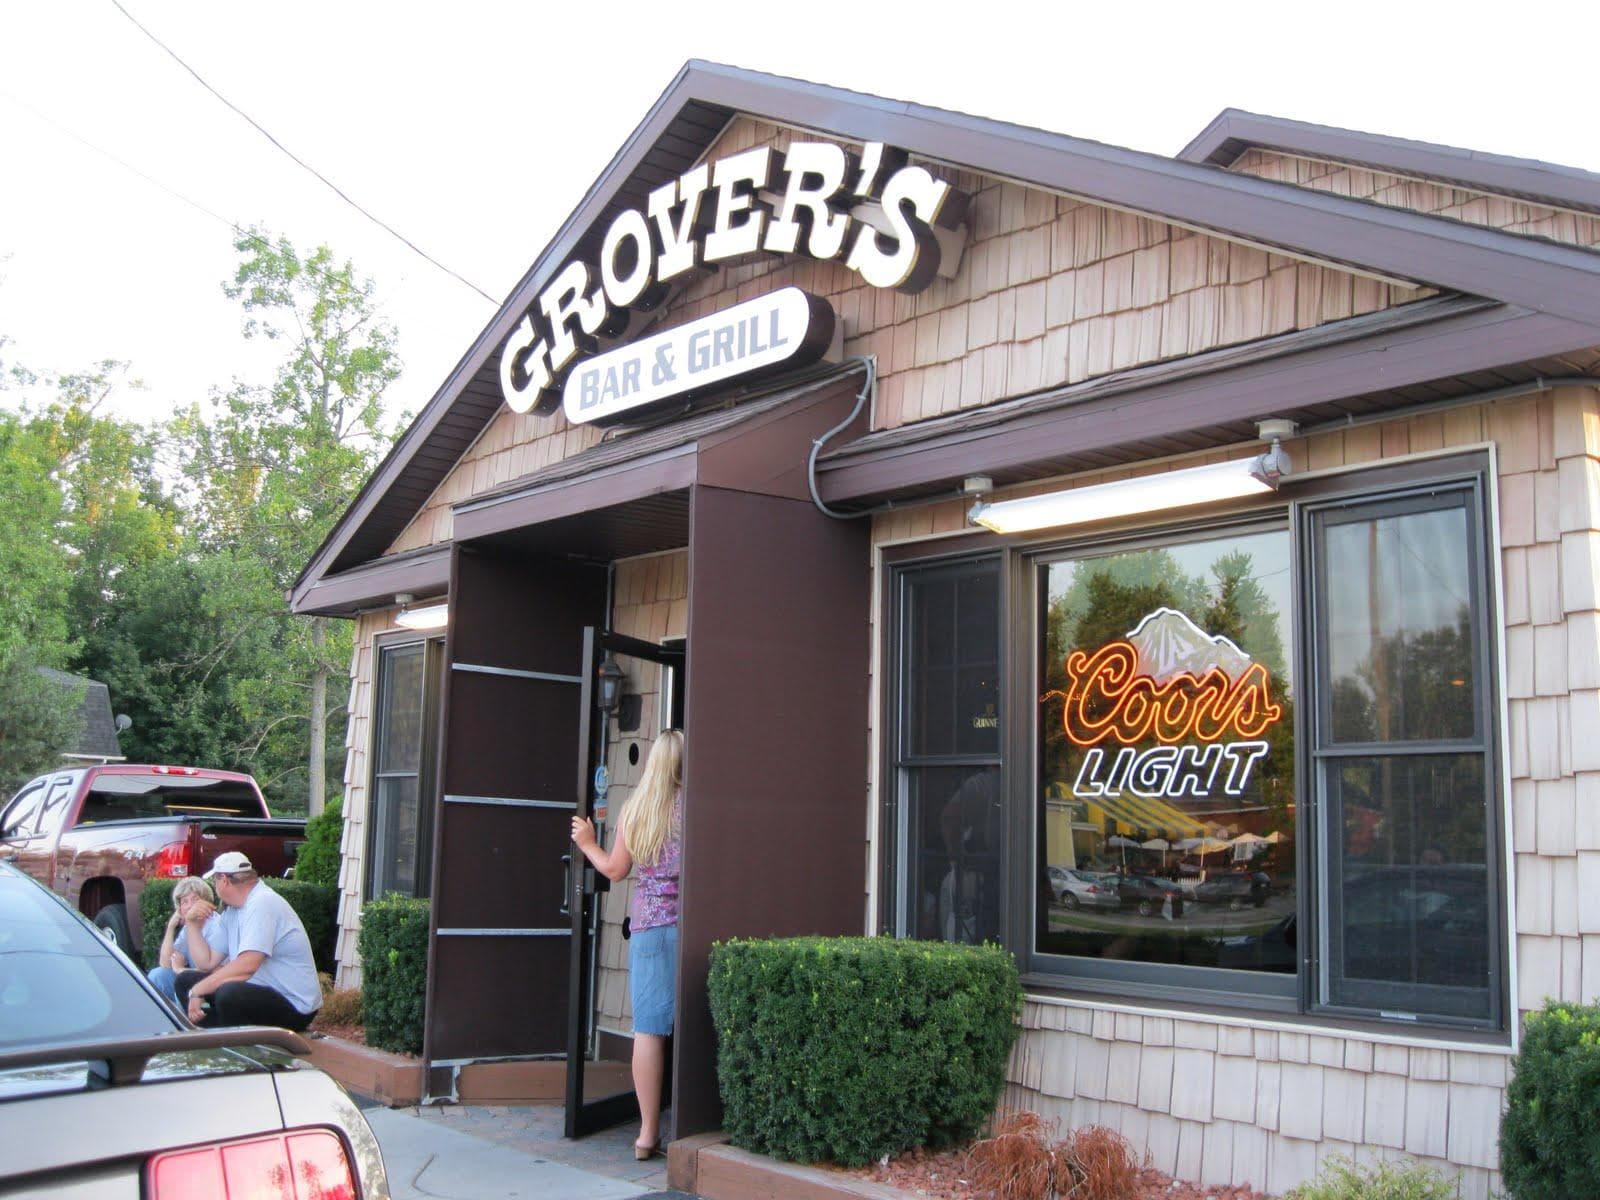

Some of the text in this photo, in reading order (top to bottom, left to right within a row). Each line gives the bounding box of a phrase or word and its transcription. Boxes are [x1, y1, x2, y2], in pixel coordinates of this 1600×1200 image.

[500, 142, 952, 414] GROVER'S
[579, 308, 788, 410] BAR & GRILL
[1064, 642, 1281, 745] Coors
[1072, 740, 1269, 797] LIGHT
